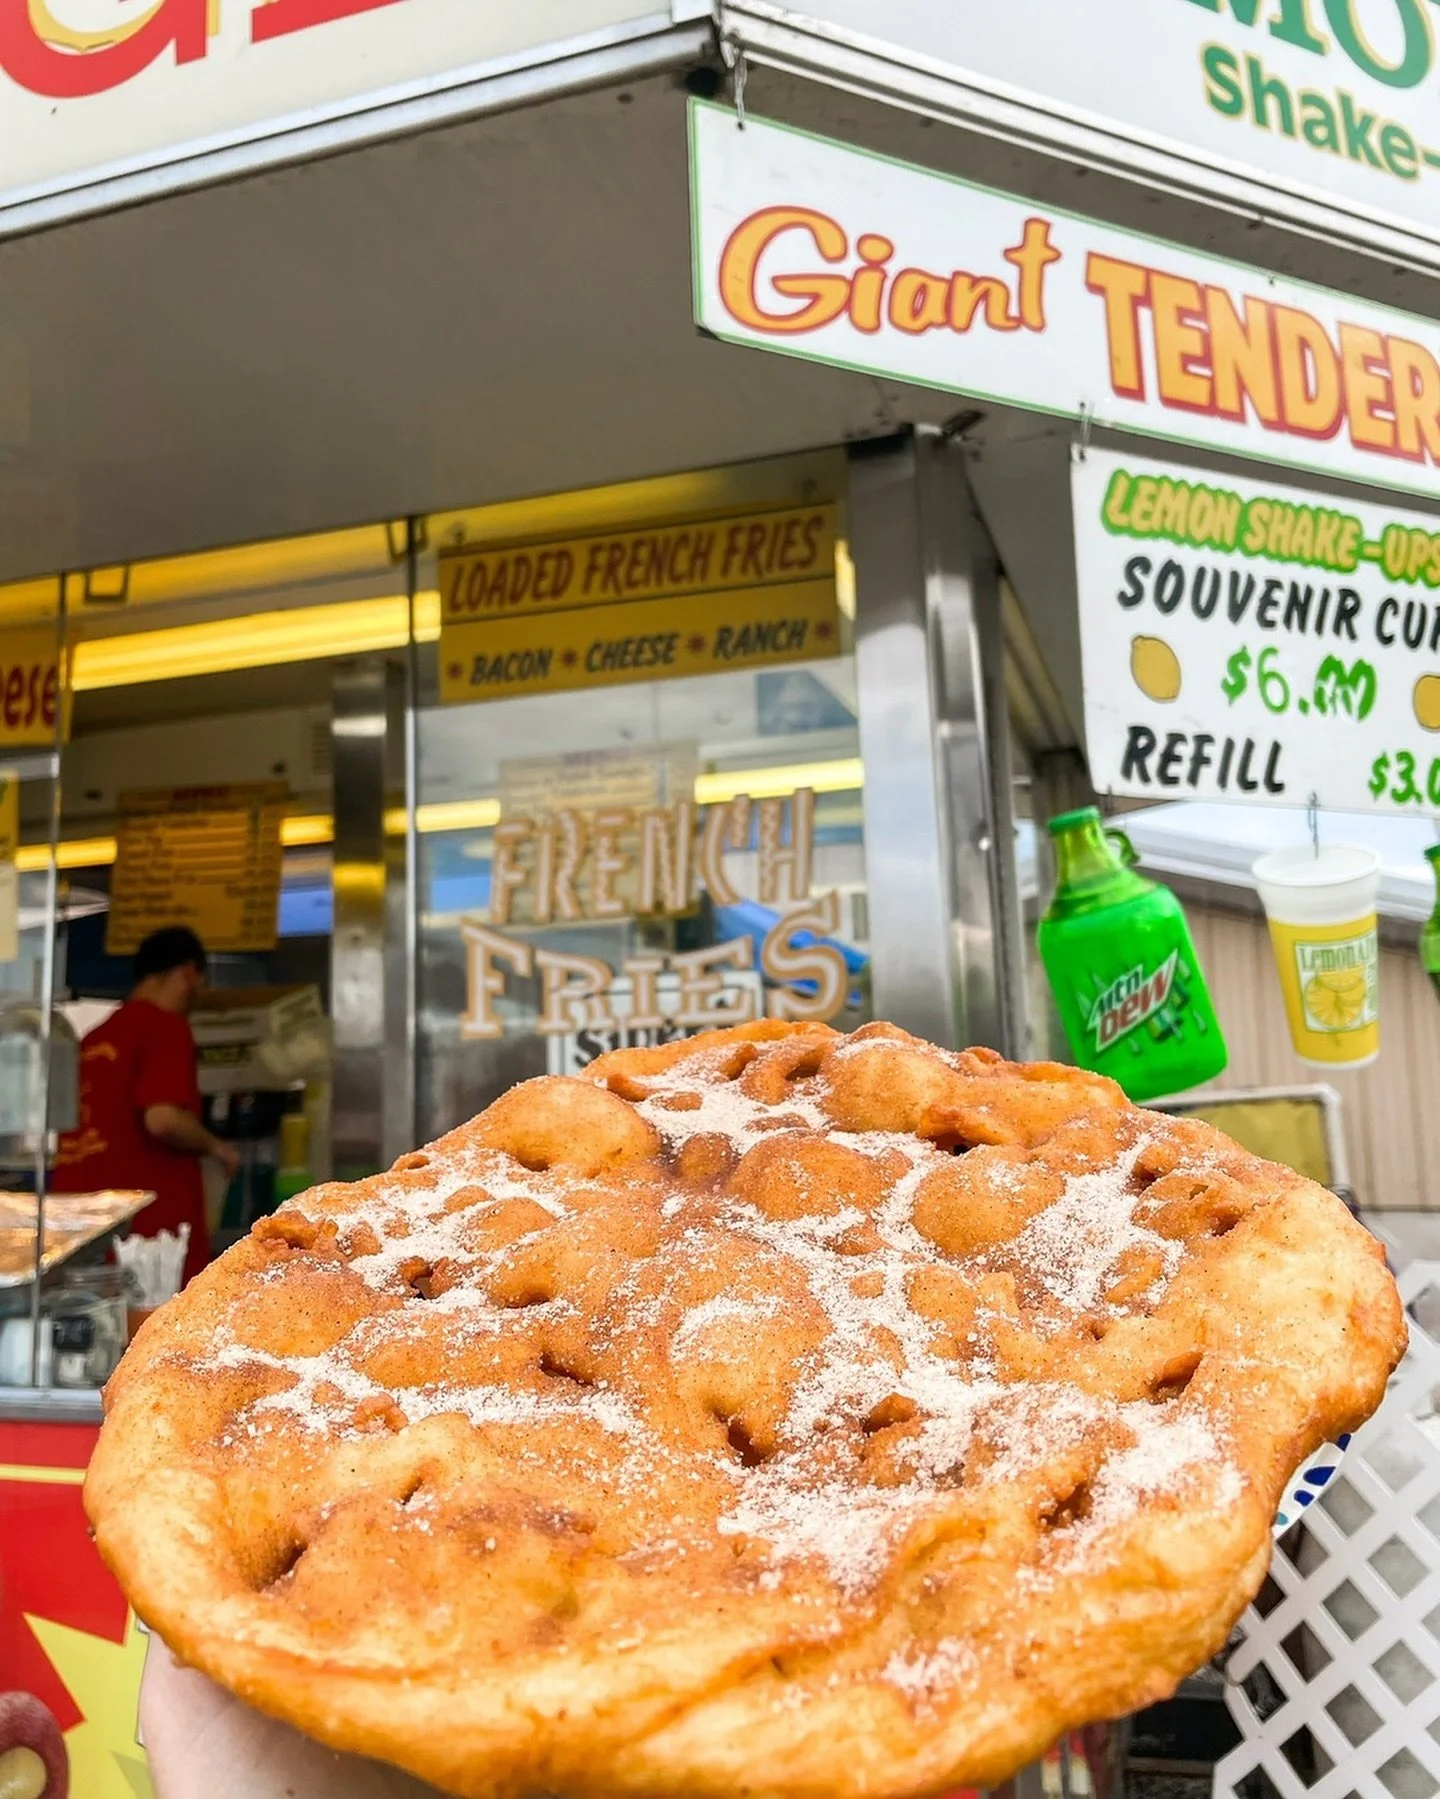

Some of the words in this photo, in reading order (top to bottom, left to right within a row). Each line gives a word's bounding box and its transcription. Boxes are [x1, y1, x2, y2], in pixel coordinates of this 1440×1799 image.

[718, 204, 1062, 335] Giant
[1101, 468, 1242, 556] LEMON
[448, 548, 575, 614] LOADED
[582, 529, 717, 598] FRENCH
[721, 515, 826, 579] FRIES
[1116, 555, 1363, 643] SOUVENIR
[0, 660, 58, 729] ese
[470, 648, 553, 687] BACON
[584, 632, 681, 674] CHEESE
[713, 617, 809, 660] RANCH
[1119, 724, 1286, 795] REFILL
[489, 786, 816, 926] FRENCH
[460, 889, 848, 1040] FRIES
